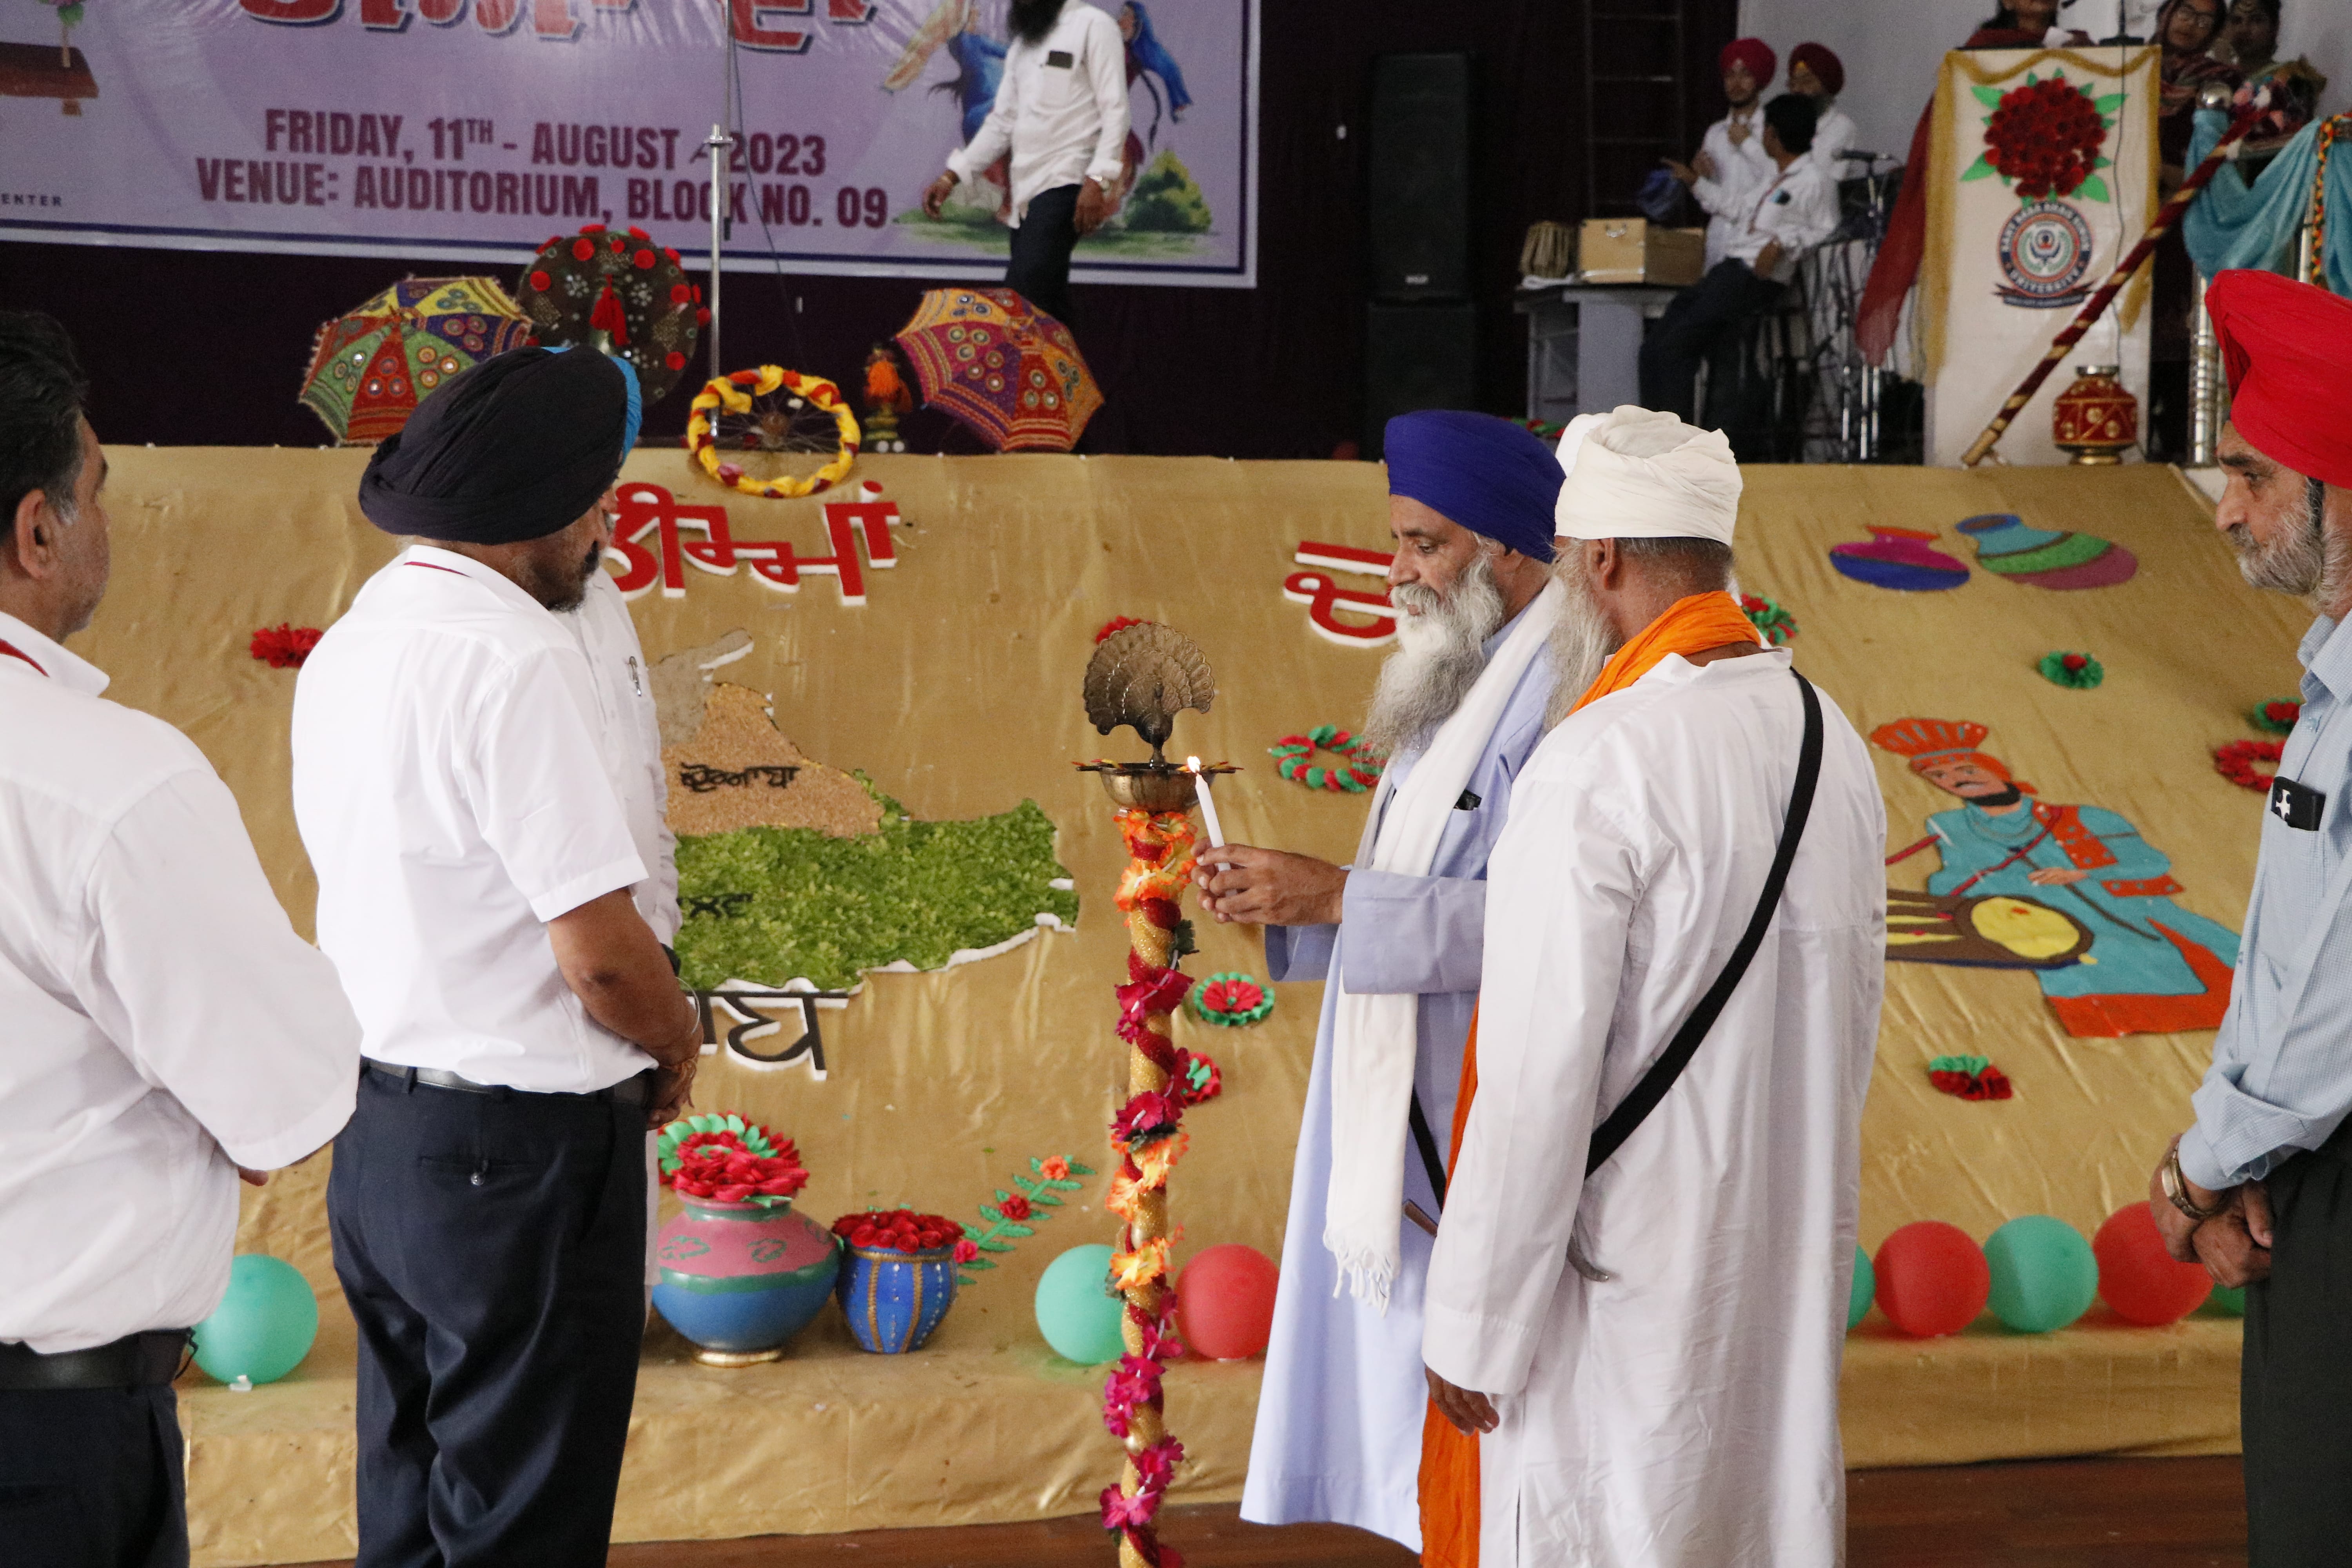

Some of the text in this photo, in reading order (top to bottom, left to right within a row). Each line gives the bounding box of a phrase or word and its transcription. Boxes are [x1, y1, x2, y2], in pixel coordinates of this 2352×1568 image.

[266, 108, 415, 165] FRIDAY,
[428, 117, 493, 160] 11TH
[532, 122, 681, 171] AUGUST
[728, 131, 826, 177] 2023
[196, 156, 339, 207] VENUE:
[354, 165, 613, 223] AUDITORIUM,
[762, 182, 822, 226] NO.
[837, 185, 888, 227] 09
[2007, 267, 2080, 294] UNIVERSITY
